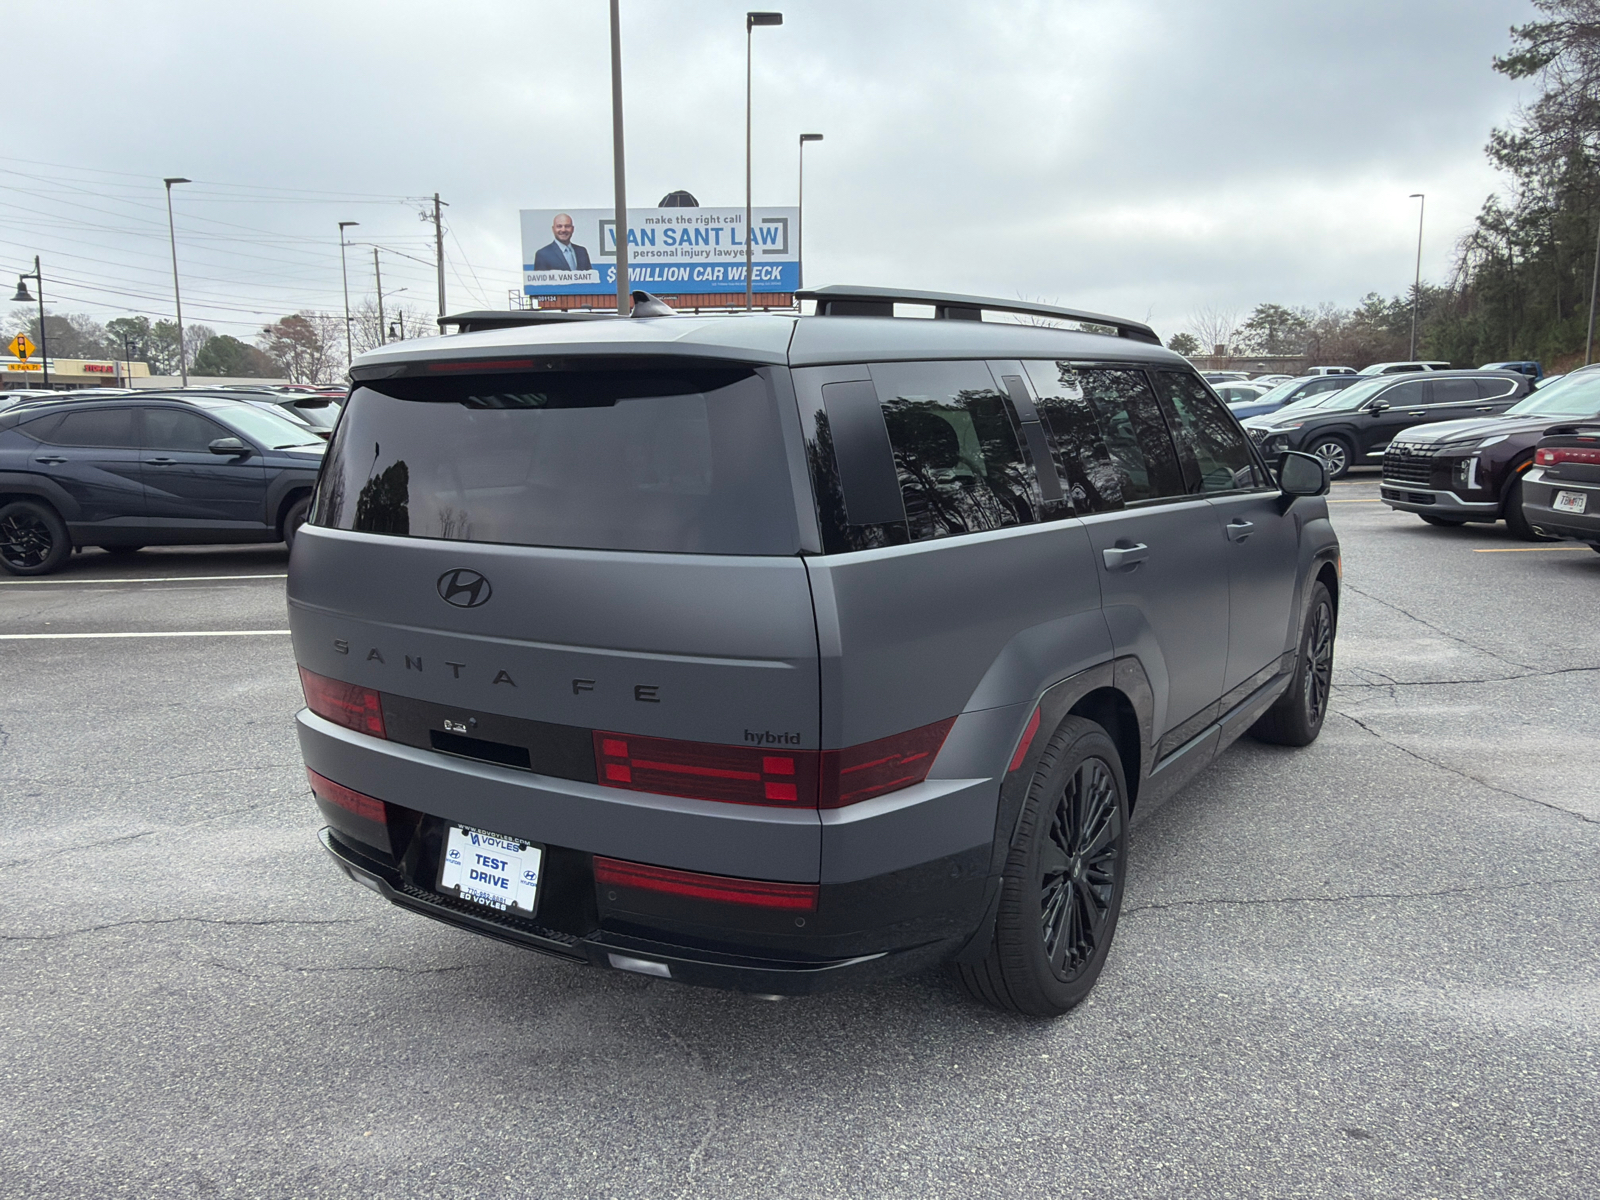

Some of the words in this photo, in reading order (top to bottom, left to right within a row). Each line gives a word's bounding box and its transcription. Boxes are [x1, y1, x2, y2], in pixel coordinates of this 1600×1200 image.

[645, 215, 673, 224] make
[676, 215, 692, 224] the
[695, 214, 721, 226] right
[723, 214, 742, 224] call
[662, 227, 724, 247] SANT
[730, 226, 779, 246] LAW
[633, 247, 678, 259] personal
[680, 247, 711, 259] injury
[527, 274, 548, 282] DAVID
[558, 273, 573, 281] VAN
[628, 267, 690, 282] MILLION
[693, 266, 724, 281] CAR
[333, 638, 519, 688] SANTA
[572, 678, 661, 703] FE
[744, 728, 801, 745] hybrid
[457, 823, 531, 846] WWW.EDVOYLES.COM
[481, 835, 520, 853] VOYLES
[475, 853, 508, 872] TEST
[469, 868, 510, 890] DRIVE
[459, 891, 472, 901] ED
[473, 895, 507, 911] VOYLES
